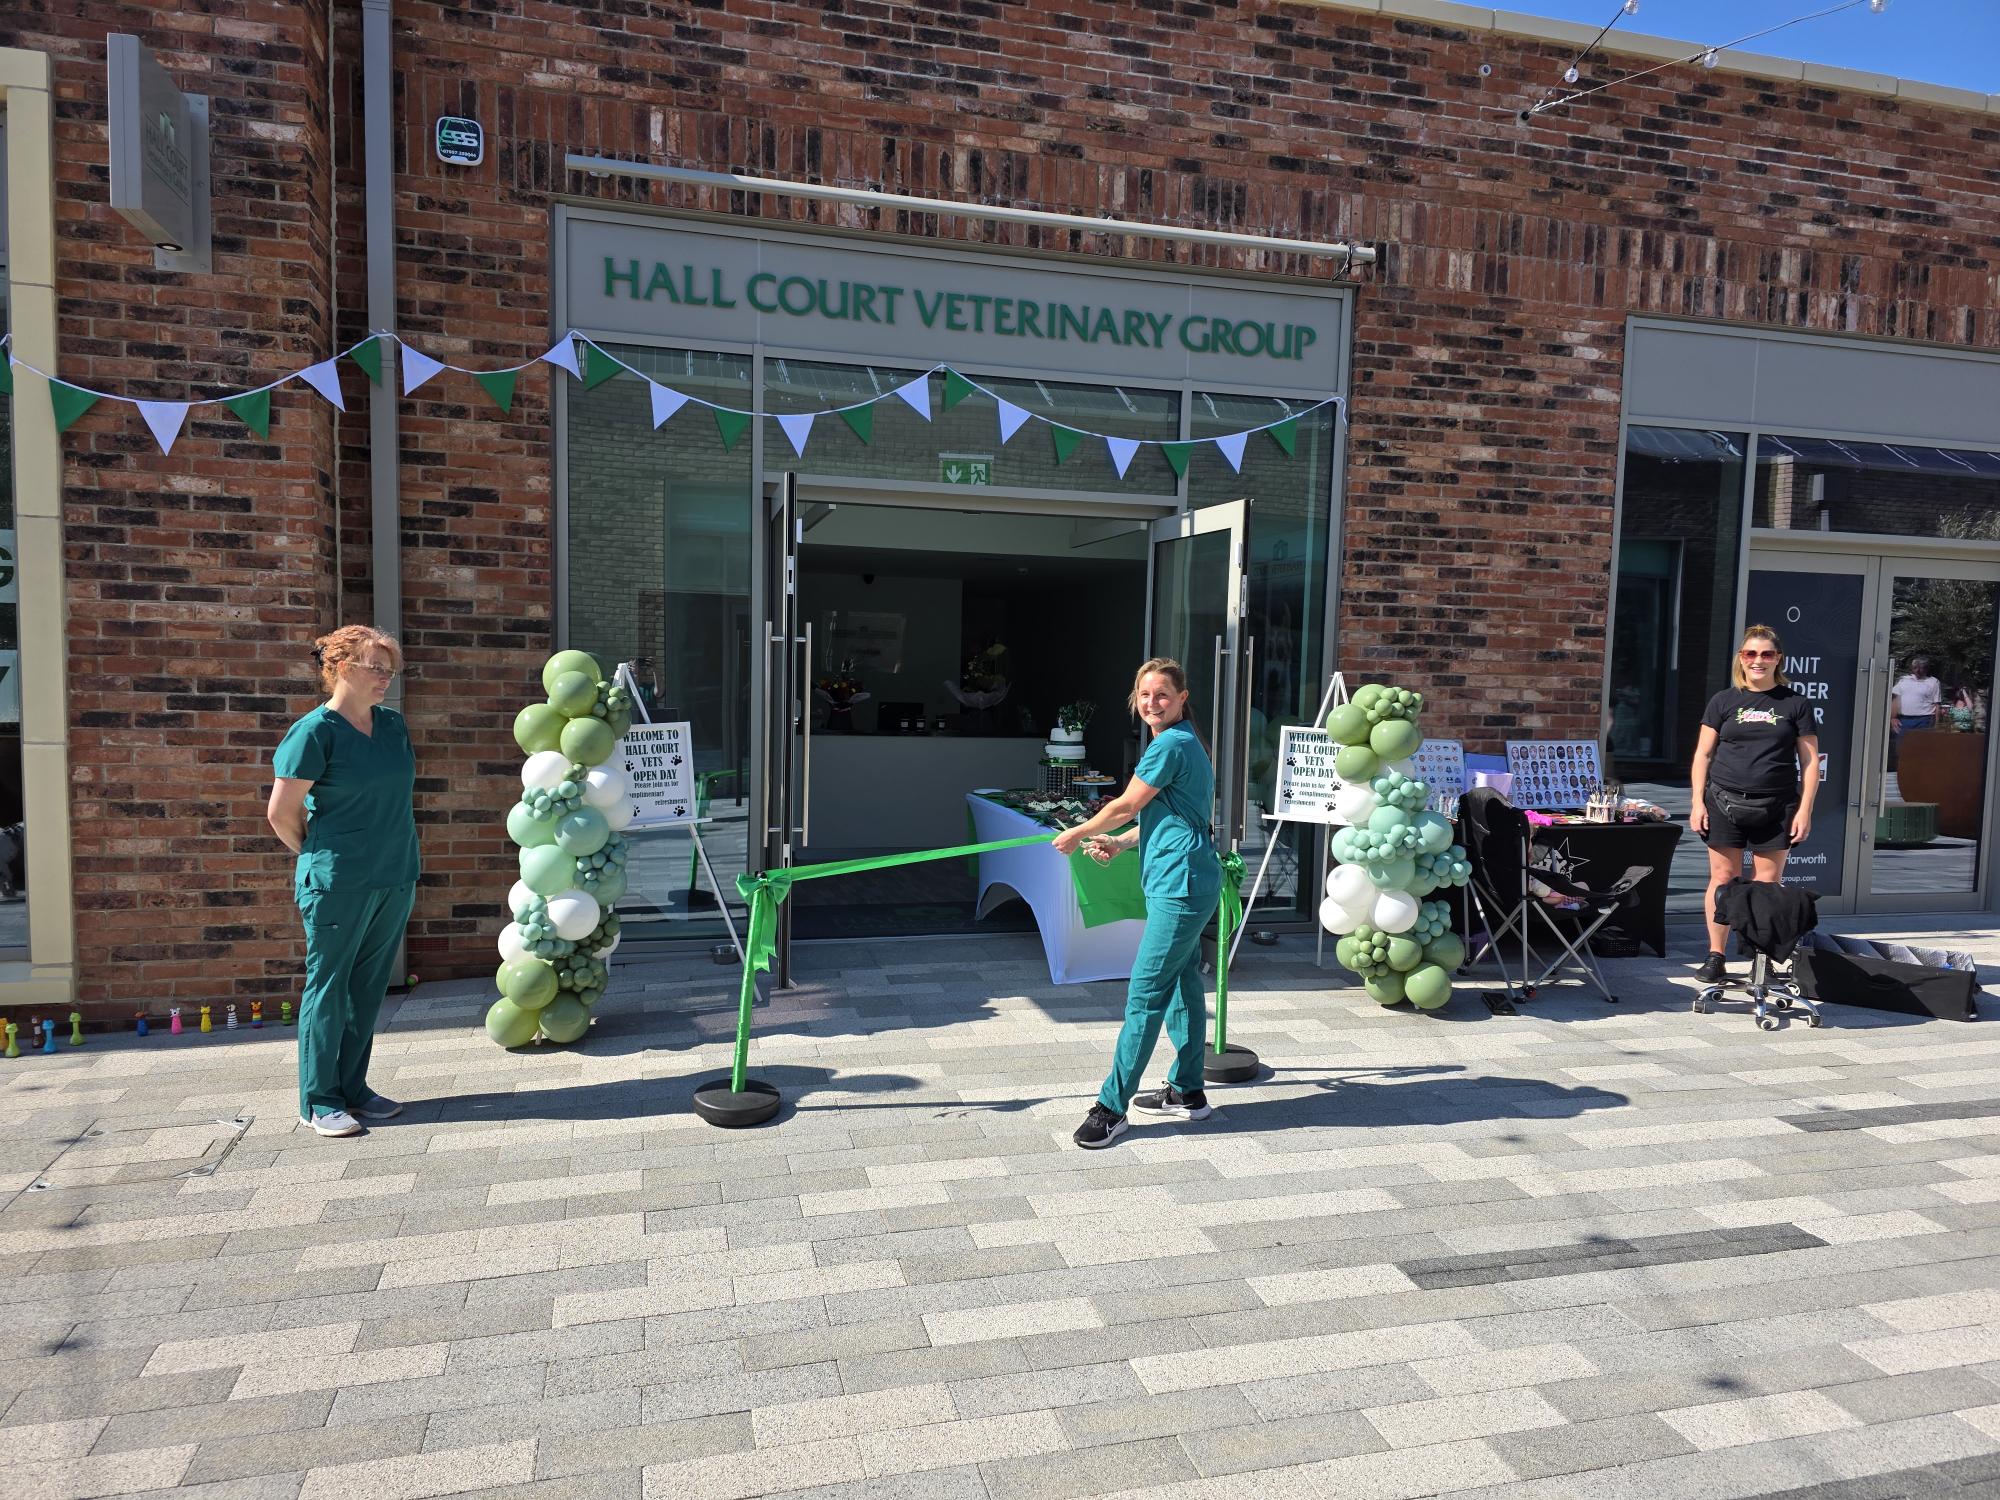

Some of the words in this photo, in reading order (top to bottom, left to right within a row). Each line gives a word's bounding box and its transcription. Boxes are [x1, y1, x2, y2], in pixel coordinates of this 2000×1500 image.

[604, 257, 736, 309] HALL
[747, 272, 904, 325] COURT
[914, 289, 1173, 349] VETERINARY
[1179, 315, 1317, 360] GROUP
[667, 730, 679, 740] TO
[1289, 732, 1329, 743] WELCOME
[625, 745, 648, 755] HALL
[651, 743, 679, 754] COURT
[1290, 744, 1310, 754] HALL
[1314, 745, 1341, 756] COURT
[641, 757, 663, 767] VETS
[1305, 756, 1325, 766] VETS
[633, 770, 657, 781] OPEN
[660, 769, 677, 780] DAY
[1293, 766, 1316, 777] OPEN
[1318, 768, 1335, 778] DAY
